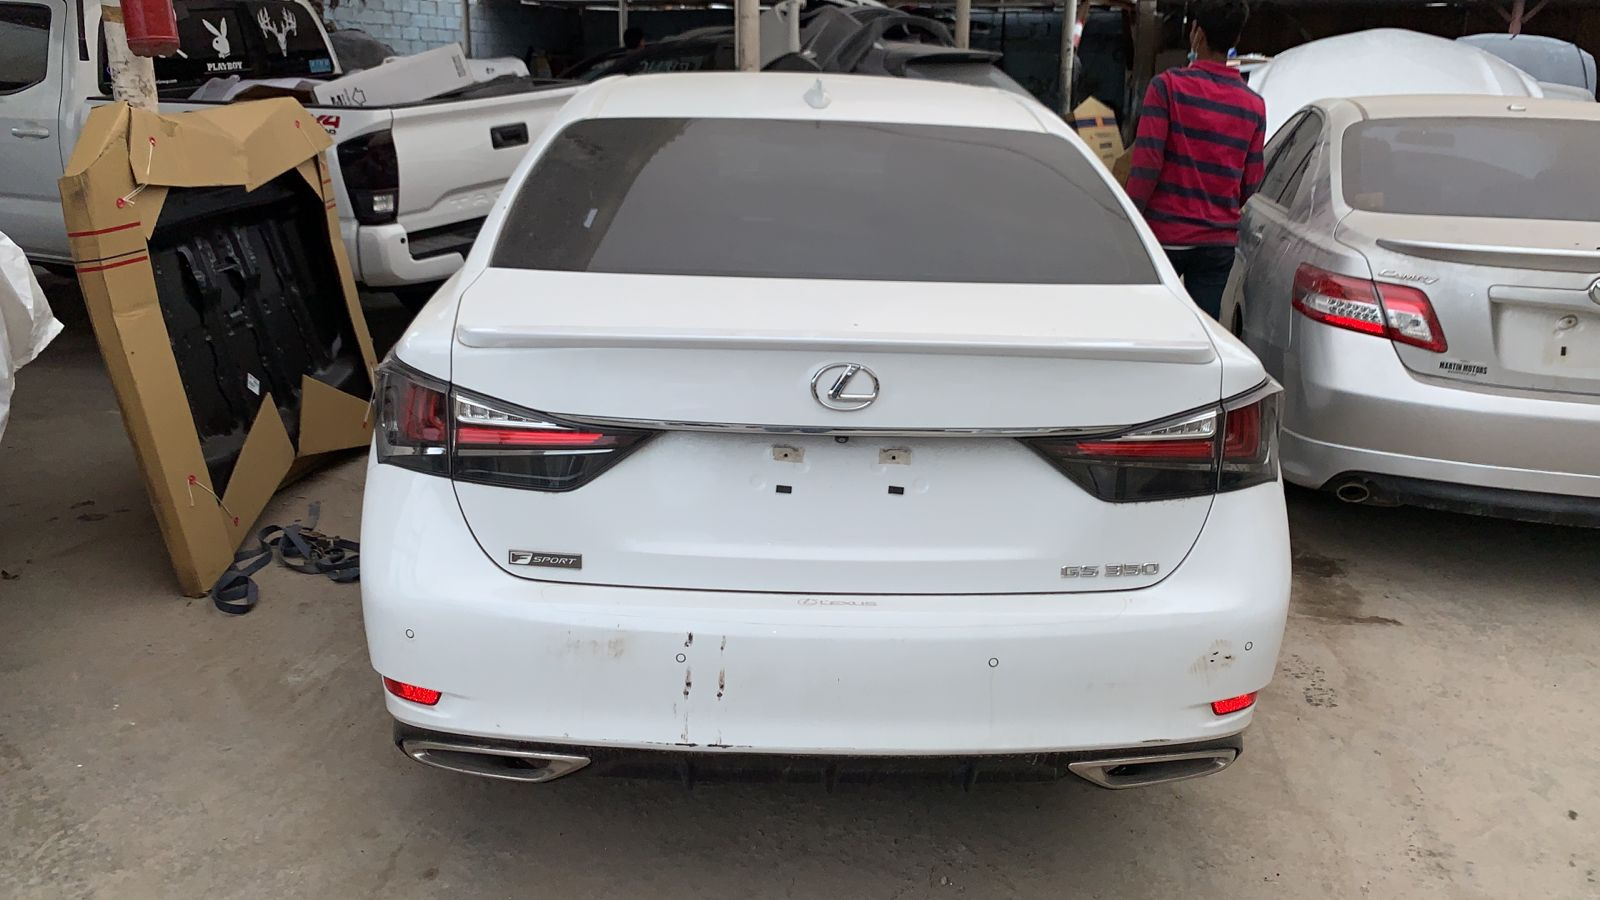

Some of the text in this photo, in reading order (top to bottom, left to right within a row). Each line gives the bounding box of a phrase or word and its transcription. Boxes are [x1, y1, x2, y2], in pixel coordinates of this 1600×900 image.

[207, 61, 242, 71] PLAYBOY
[1439, 361, 1463, 371] MARTIN
[1463, 364, 1488, 375] MOTORS
[532, 556, 577, 565] SPORT
[1061, 562, 1160, 579] GS 350
[820, 599, 877, 608] LEXUS
